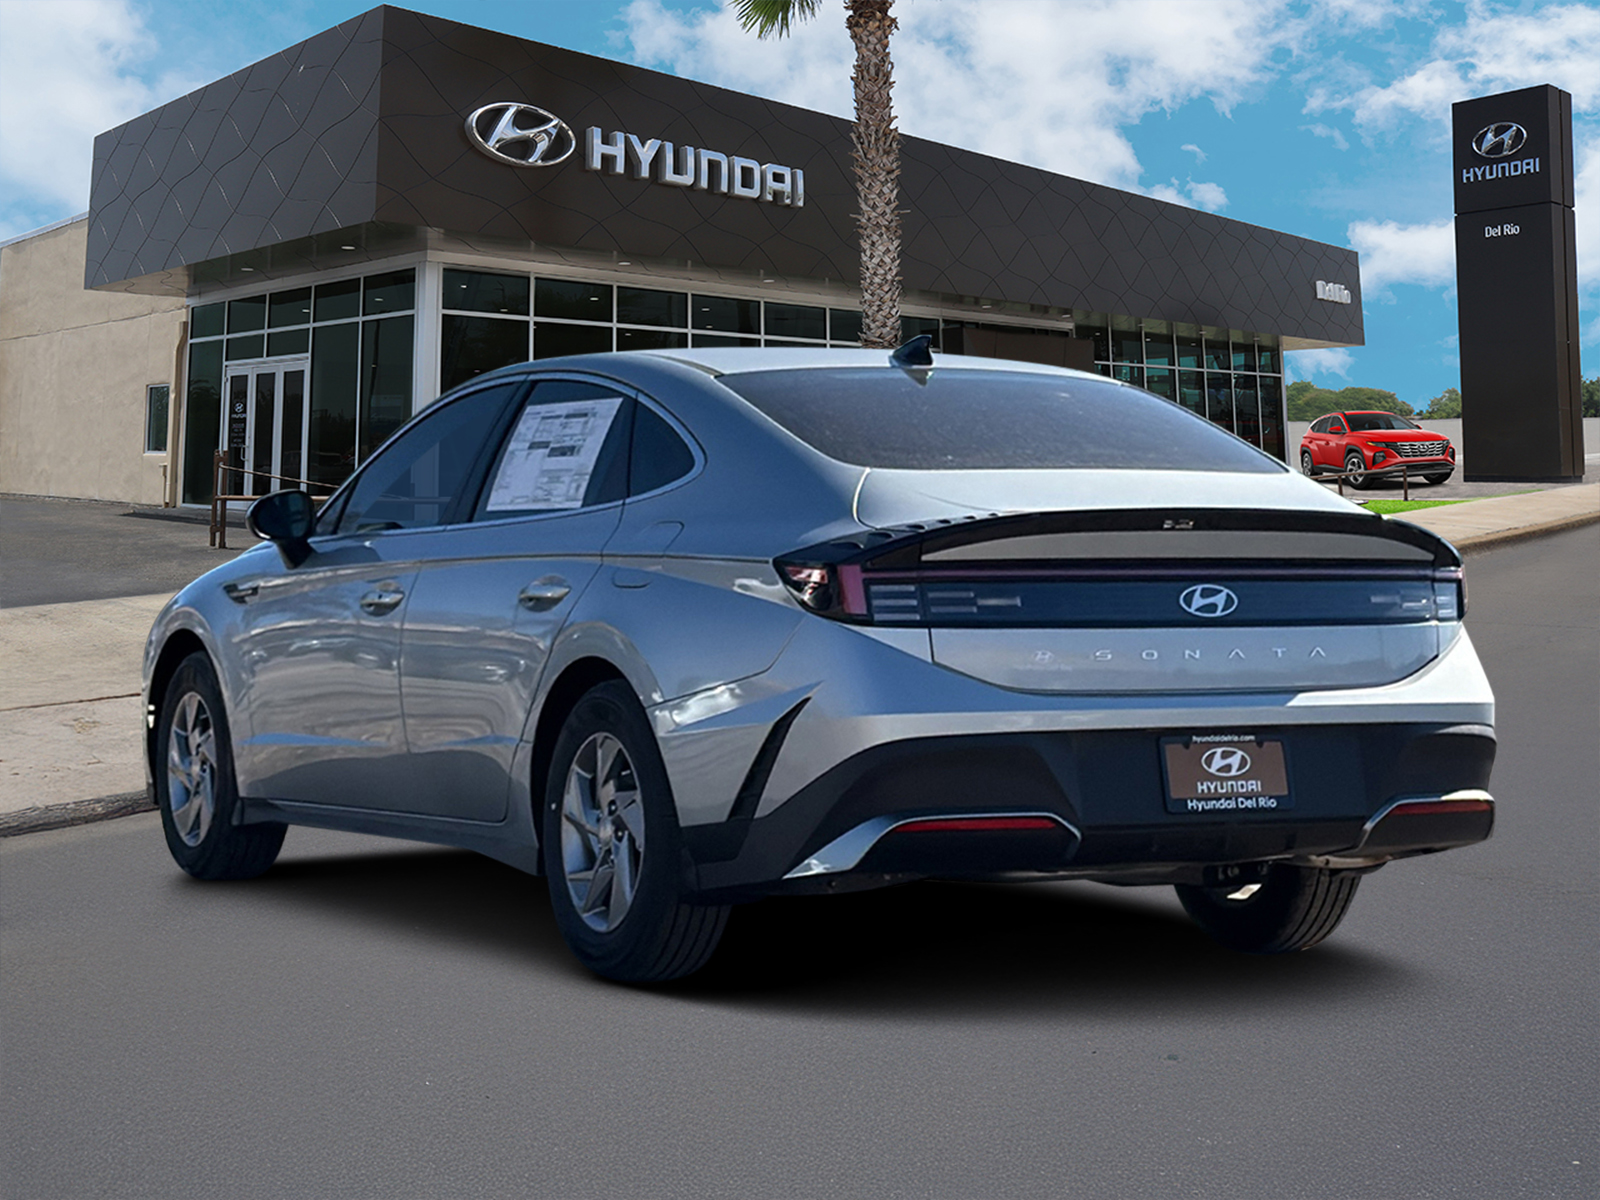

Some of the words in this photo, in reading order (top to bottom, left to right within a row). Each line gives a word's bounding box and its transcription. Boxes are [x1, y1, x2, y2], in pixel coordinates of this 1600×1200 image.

[585, 126, 805, 208] HYUNDAI
[1462, 157, 1540, 184] HYUNDAI
[1484, 225, 1501, 238] Del
[1503, 223, 1520, 236] Rio
[1093, 646, 1327, 661] SONATA
[1197, 780, 1262, 794] HYUNDAI
[1187, 798, 1237, 811] Hyundai
[1238, 797, 1257, 809] Del
[1258, 797, 1278, 808] Rio
